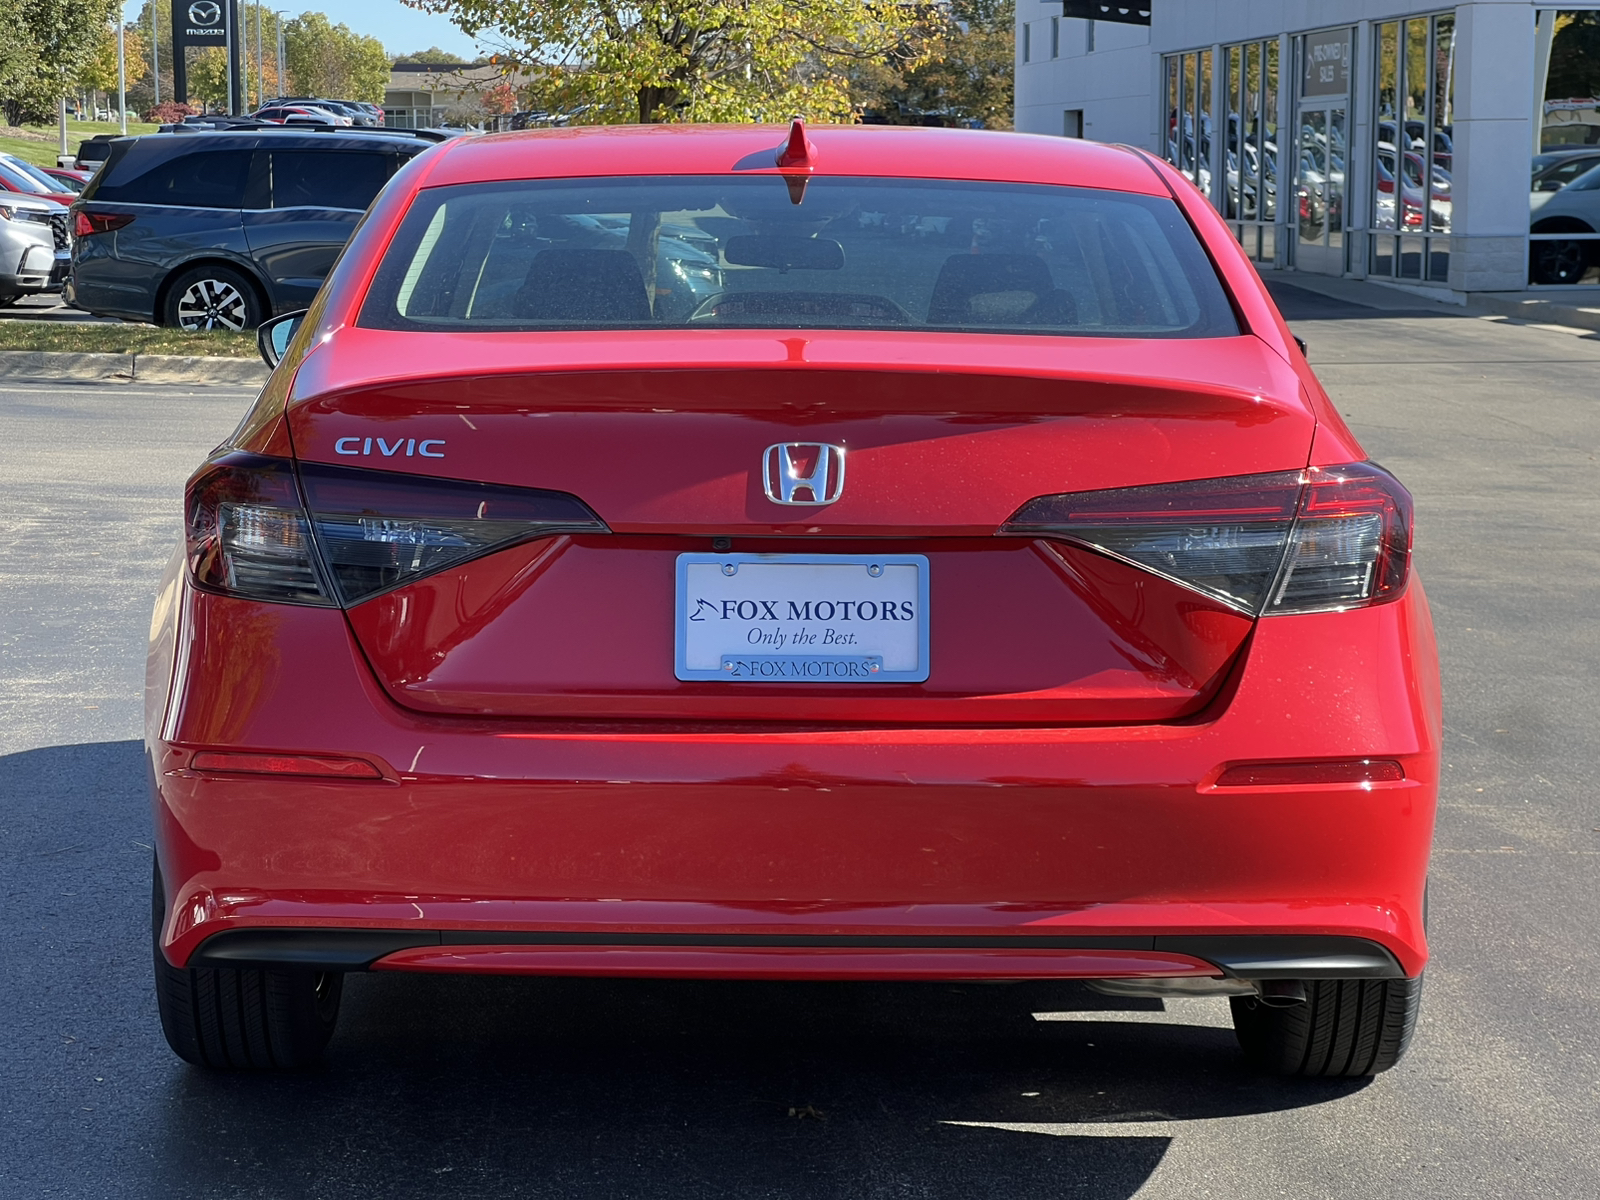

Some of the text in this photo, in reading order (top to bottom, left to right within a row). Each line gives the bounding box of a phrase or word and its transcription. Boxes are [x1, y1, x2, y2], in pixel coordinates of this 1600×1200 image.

[334, 437, 446, 458] CIVIC
[720, 600, 914, 621] FOX MOTORS
[747, 627, 858, 649] Only the Best.
[750, 661, 870, 677] FOX MOTORS
